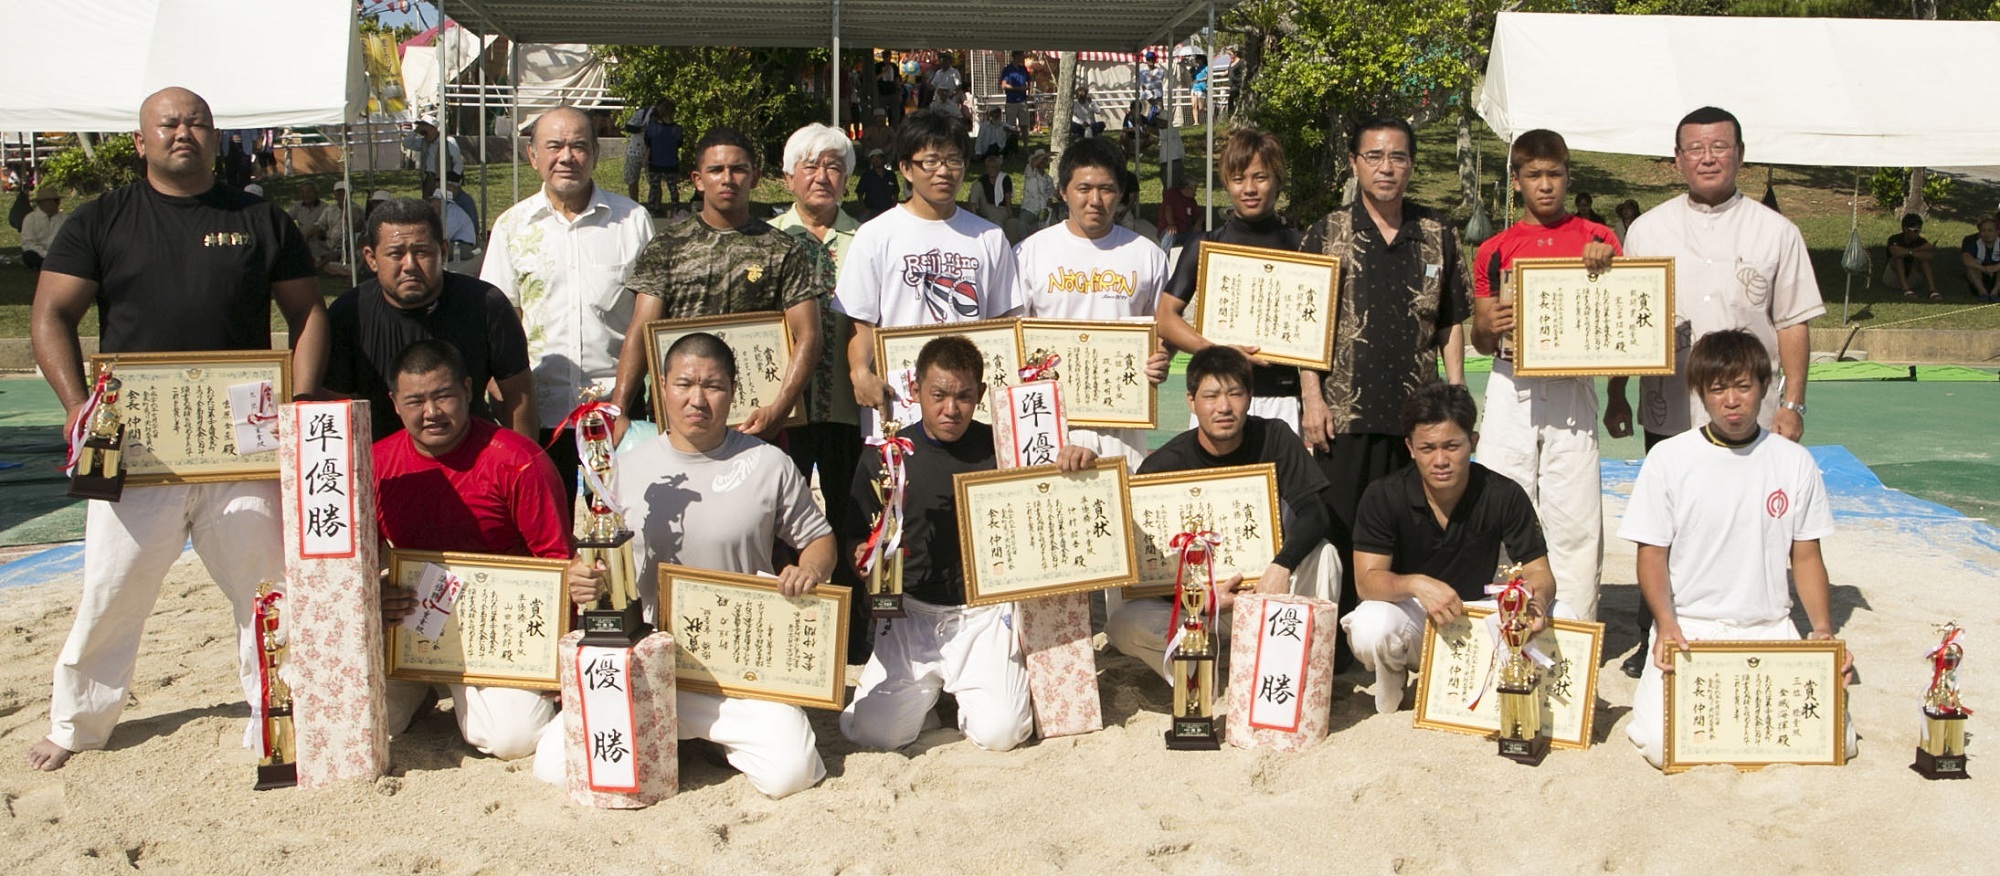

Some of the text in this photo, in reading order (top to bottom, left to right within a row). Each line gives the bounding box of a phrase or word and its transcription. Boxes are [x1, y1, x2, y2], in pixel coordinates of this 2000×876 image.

[1301, 288, 1317, 323] 賞状
[1636, 292, 1653, 328] 賞状
[763, 347, 781, 382] 賞状
[1122, 353, 1138, 386] 賞状
[305, 413, 347, 538] 準優勝
[1092, 498, 1111, 538] 賞状
[1242, 503, 1260, 540] 賞状
[526, 598, 545, 638] 賞状
[683, 615, 704, 654] 賞状
[1258, 607, 1303, 705] 優勝
[1552, 658, 1573, 698] 賞状
[584, 653, 630, 764] 優勝
[1801, 680, 1821, 719] 賞状
